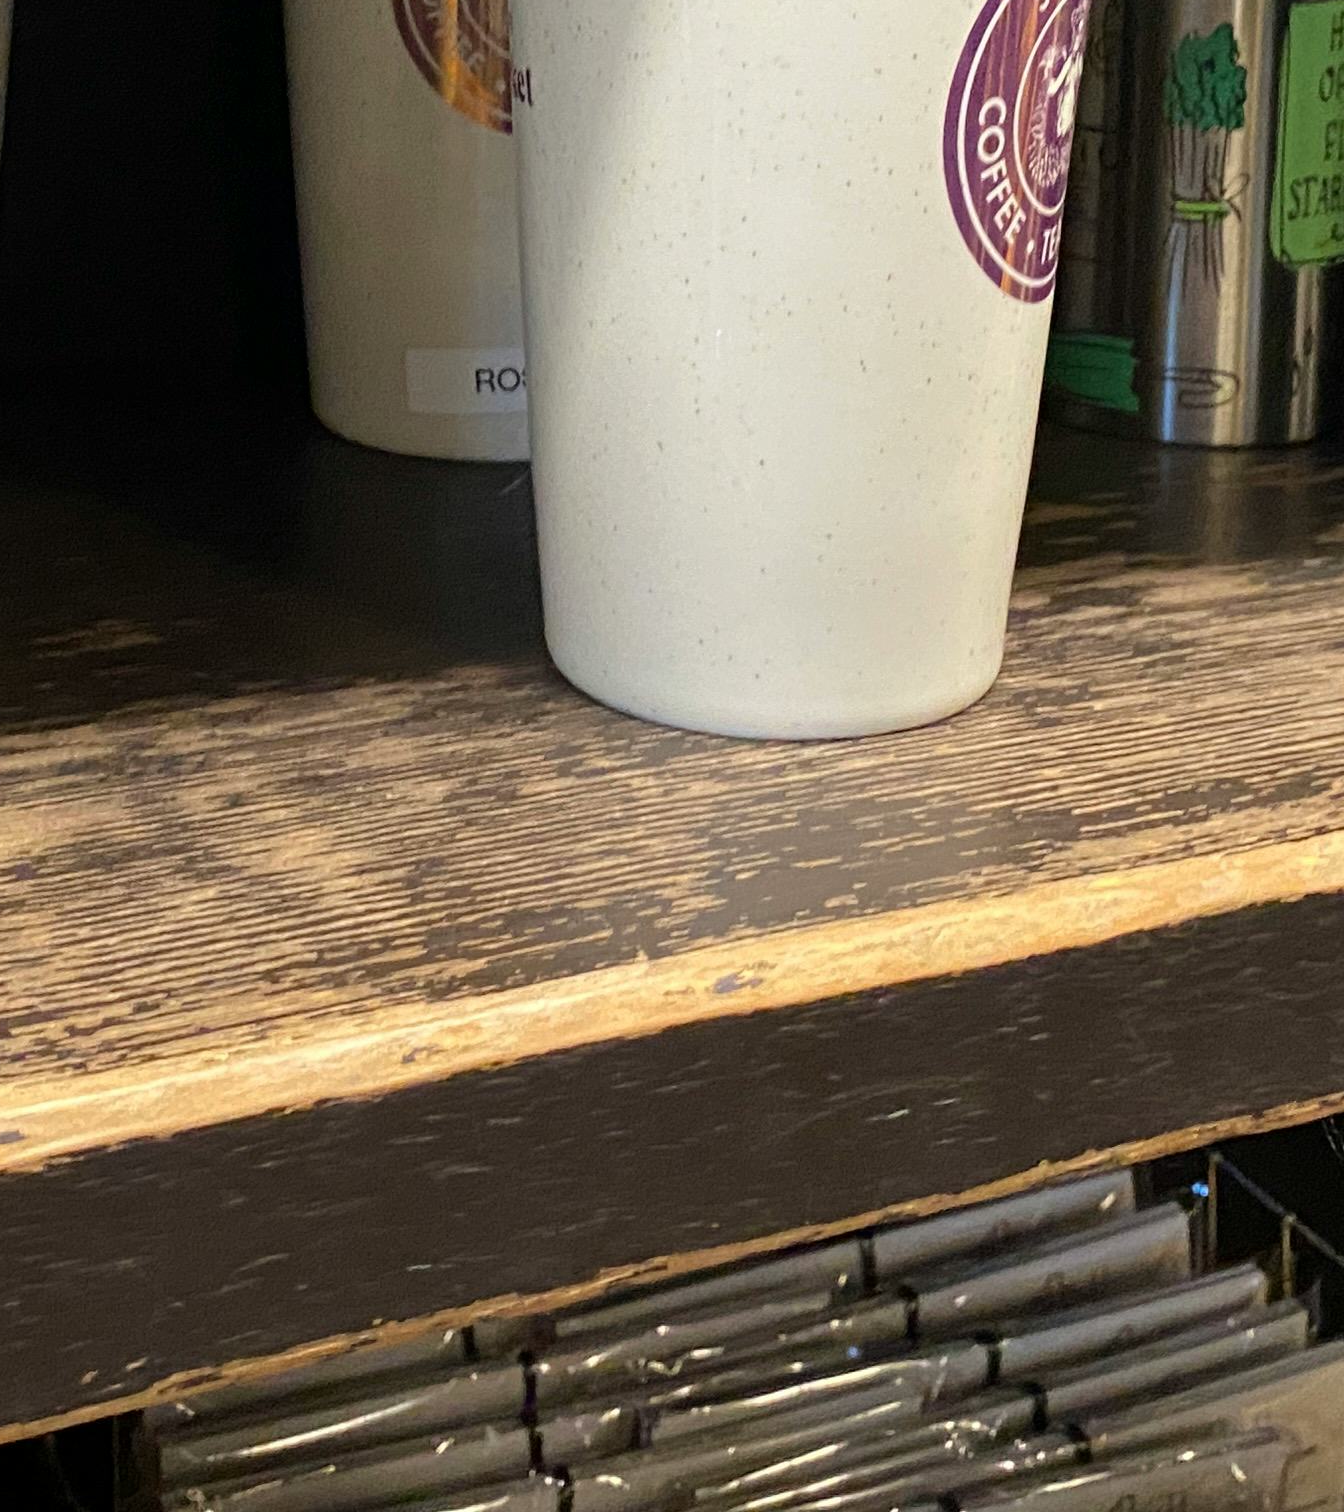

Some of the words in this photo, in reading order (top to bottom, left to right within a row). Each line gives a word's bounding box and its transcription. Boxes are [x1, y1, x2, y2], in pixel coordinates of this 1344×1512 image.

[976, 96, 1027, 246] COFFEE
[1040, 223, 1062, 266] TE
[474, 367, 527, 393] RO
